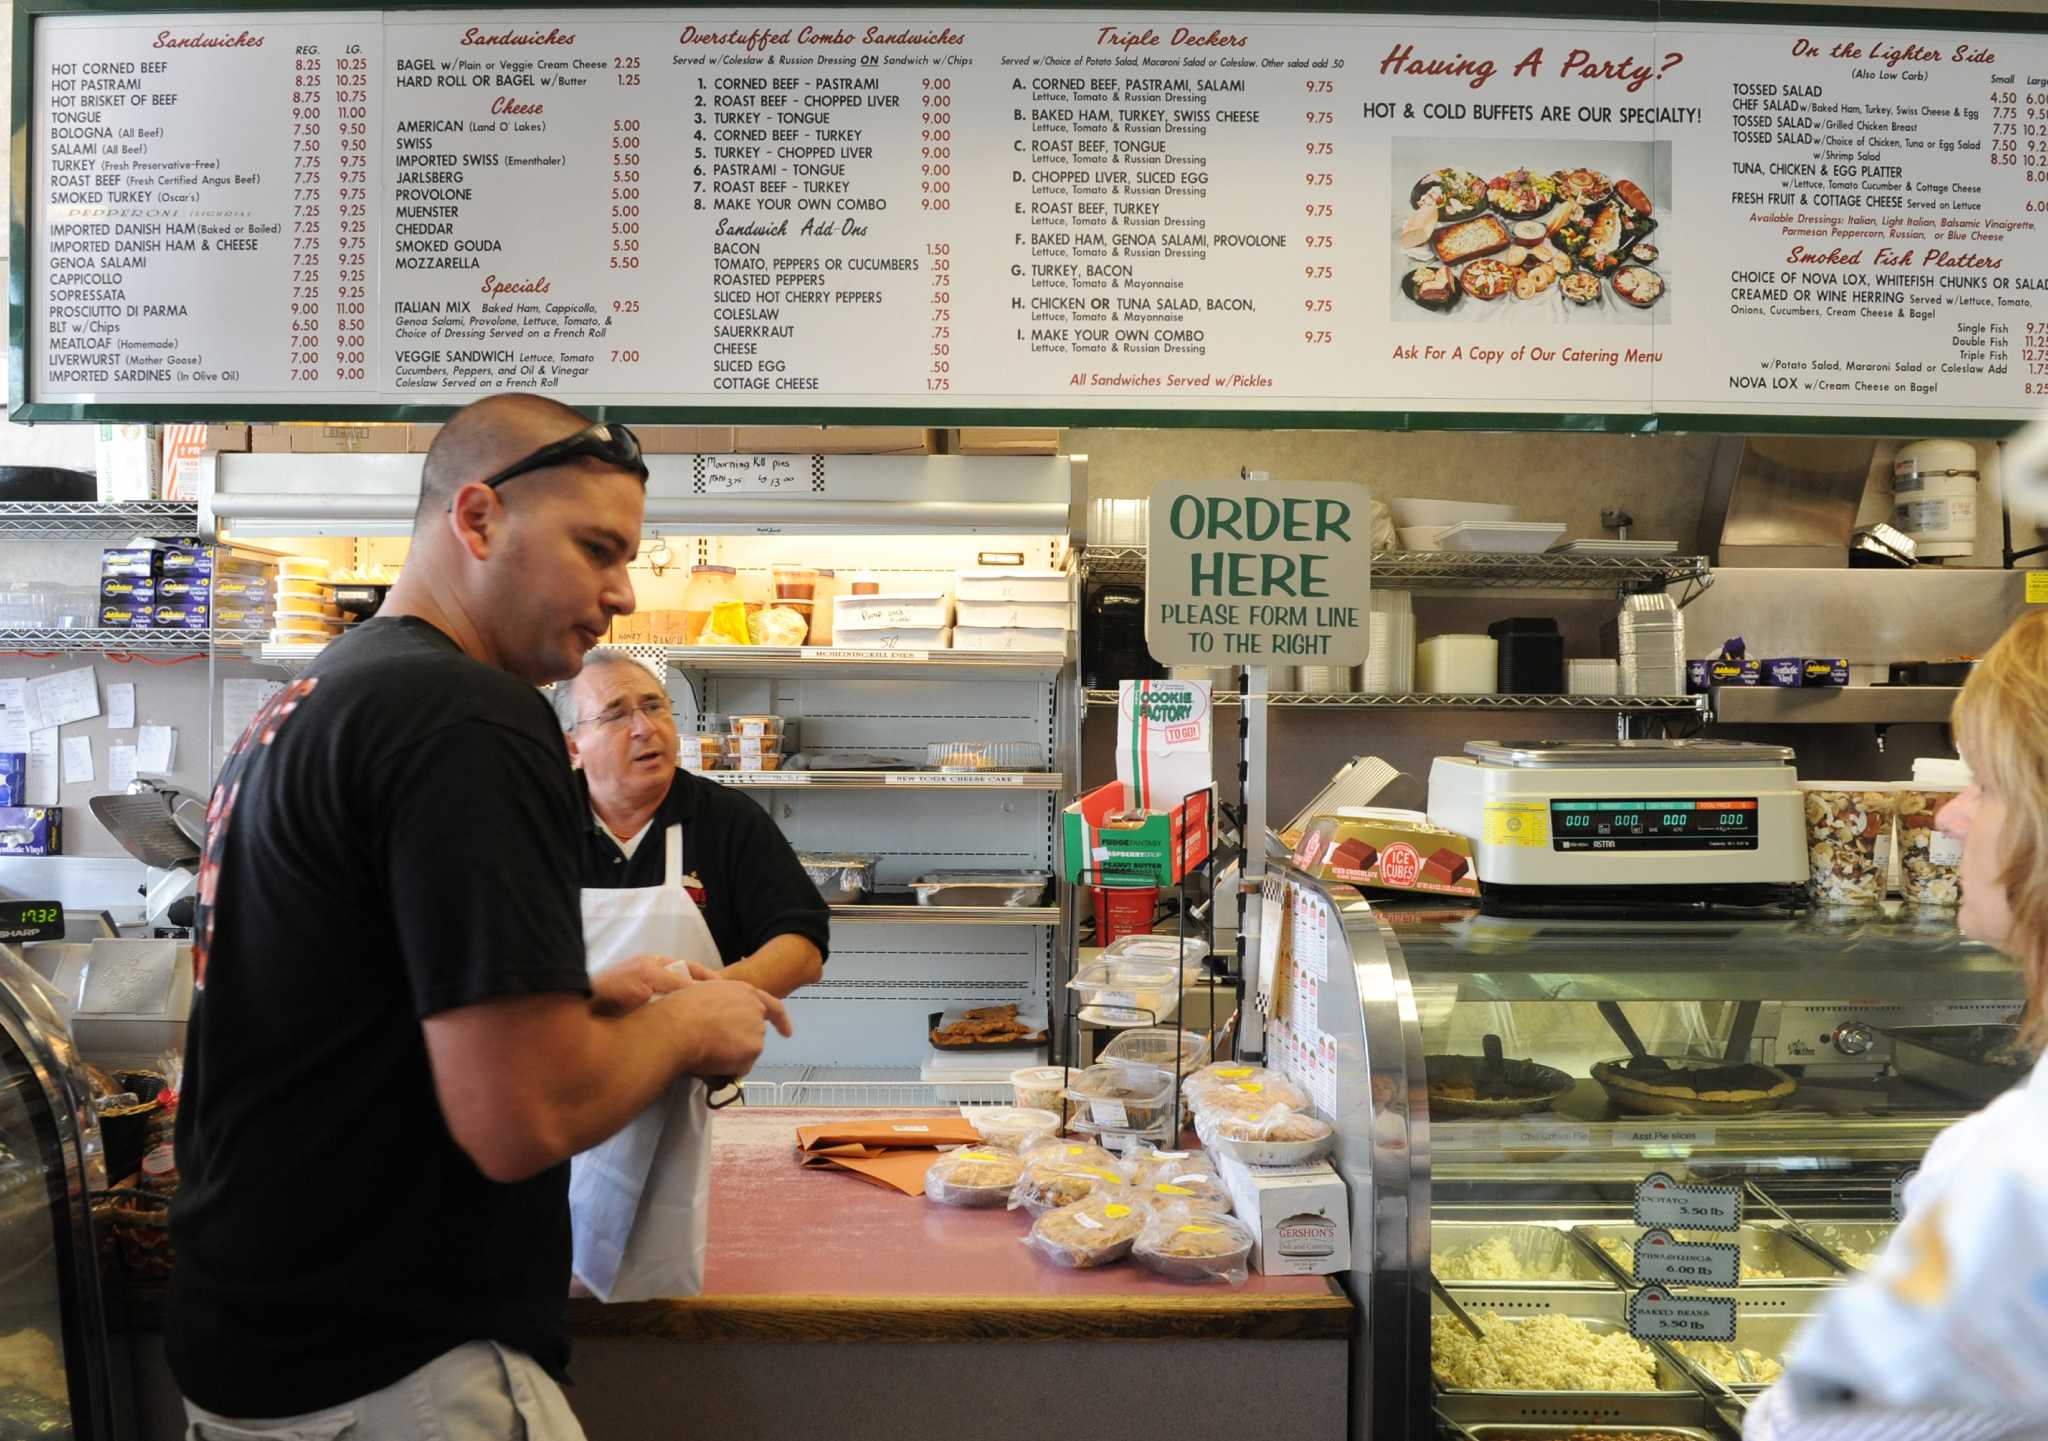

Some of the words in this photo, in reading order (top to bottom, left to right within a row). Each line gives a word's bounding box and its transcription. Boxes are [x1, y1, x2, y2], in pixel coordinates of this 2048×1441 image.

[152, 30, 265, 49] Sandwiches
[460, 27, 576, 46] Sandwiches
[680, 26, 792, 52] Overstuffed
[797, 26, 856, 45] Combo
[862, 26, 965, 45] Sandwiches
[1097, 26, 1160, 52] Triple
[1170, 27, 1248, 48] Deckers
[295, 45, 320, 55] REG.
[345, 44, 362, 55] LG.
[1792, 38, 1820, 58] On
[1829, 42, 1862, 59] the
[1868, 42, 1942, 68] Lighter
[1951, 44, 1995, 64] Side
[52, 63, 78, 75] HOT
[82, 62, 135, 75] CORNED
[140, 61, 168, 74] BEEF
[296, 58, 321, 70] 8.25
[336, 58, 367, 70] 10.25
[1380, 44, 1497, 89] Having
[1513, 47, 1544, 78] A
[1560, 48, 1684, 93] Party?
[1852, 68, 1876, 80] (Also
[1879, 70, 1898, 80] Low
[1901, 70, 1928, 81] Carb)
[1990, 74, 2015, 84] Small
[697, 78, 707, 90] 1.
[714, 78, 768, 90] CORNED
[772, 78, 800, 90] BEEF
[816, 78, 879, 90] PASTRAMI
[922, 78, 951, 90] 9.00
[1012, 78, 1026, 90] A.
[1032, 78, 1086, 90] CORNED
[1090, 78, 1120, 92] BEEF,
[1126, 78, 1192, 92] PASTRAMI,
[1197, 79, 1245, 92] SALAMI
[1306, 80, 1333, 93] 9.75
[1733, 82, 1778, 96] TOSSED
[1782, 84, 1822, 98] SALAD
[1990, 92, 2017, 104] 4.50
[491, 96, 543, 115] Cheese
[1364, 102, 1396, 118] HOT
[1403, 102, 1415, 119] &
[1423, 103, 1466, 120] COLD
[1473, 104, 1534, 121] BUFFETS
[1540, 105, 1571, 122] ARE
[1578, 106, 1612, 123] OUR
[1619, 107, 1701, 124] SPECIALTY!
[51, 111, 101, 124] TONGUE
[292, 107, 320, 120] 9.00
[338, 106, 367, 119] 11.00
[396, 137, 433, 150] SWISS
[612, 136, 640, 149] 5.00
[396, 171, 464, 184] JARLSBERG
[613, 170, 640, 183] 5.50
[396, 206, 458, 218] MUENSTER
[612, 204, 640, 218] 5.00
[715, 217, 789, 237] Sandwich
[800, 216, 868, 237] Add-Ons
[714, 242, 760, 255] BACON
[926, 243, 950, 256] 1.50
[395, 256, 480, 270] MOZZARELLA
[610, 256, 639, 269] 5.50
[1786, 245, 1863, 265] Smoked
[1873, 247, 1914, 266] Fish
[1922, 248, 2003, 269] Platters
[50, 288, 126, 302] SOPRESSATA
[293, 286, 319, 298] 7.25
[338, 286, 365, 298] 9.25
[481, 274, 551, 300] Specials
[714, 326, 794, 338] SAUERKRAUT
[1017, 328, 1025, 340] I.
[1031, 328, 1069, 341] MAKE
[1074, 328, 1109, 341] YOUR
[1115, 329, 1149, 341] OWN
[1154, 329, 1204, 342] COMBO
[1304, 330, 1332, 343] 9.75
[50, 337, 112, 350] MEATLOAF
[117, 338, 178, 350] (Homemade)
[1031, 342, 1068, 353] Lettuce,
[1071, 342, 1107, 352] Tomato
[1111, 342, 1119, 353] &
[1123, 342, 1160, 353] Russian
[1164, 342, 1206, 356] Dressing
[1392, 344, 1419, 360] Ask
[1424, 345, 1446, 360] For
[1451, 346, 1462, 360] A
[1469, 346, 1504, 364] Copy
[1510, 345, 1526, 361] of
[1530, 347, 1556, 361] Our
[1562, 347, 1619, 366] Catering
[1624, 348, 1663, 363] Menu
[1070, 372, 1087, 386] All
[1090, 372, 1161, 386] Sandwiches
[1166, 374, 1211, 386] Served
[1215, 374, 1272, 387] w/Pickles
[1729, 376, 1767, 389] NOVA
[1772, 377, 1798, 389] LOX
[1804, 378, 1850, 390] w/Cream
[1854, 380, 1890, 391] Cheese
[1894, 384, 1906, 392] on
[1910, 382, 1938, 394] Bagel
[1170, 494, 1351, 542] ORDER
[1191, 552, 1330, 598] HERE
[1161, 604, 1240, 625] PLEASE
[1250, 605, 1307, 627] FORM
[1317, 607, 1359, 628] LINE
[1188, 632, 1213, 653] TO
[1223, 633, 1262, 654] THE
[1272, 634, 1332, 655] RIGHT
[1141, 691, 1192, 704] COOKIE
[1140, 704, 1192, 722] FACTORY
[1168, 729, 1180, 740] TO
[1593, 839, 1616, 848] ASTRA
[1392, 850, 1409, 865] ICE
[1386, 863, 1414, 879] CUBES
[1679, 1207, 1708, 1216] 5.50
[1710, 1207, 1724, 1216] lb
[1279, 1228, 1334, 1239] GERSHON'S
[1666, 1265, 1695, 1275] 6.00
[1698, 1266, 1712, 1276] lb
[1659, 1319, 1687, 1329] 5.50
[1690, 1321, 1705, 1330] lb
